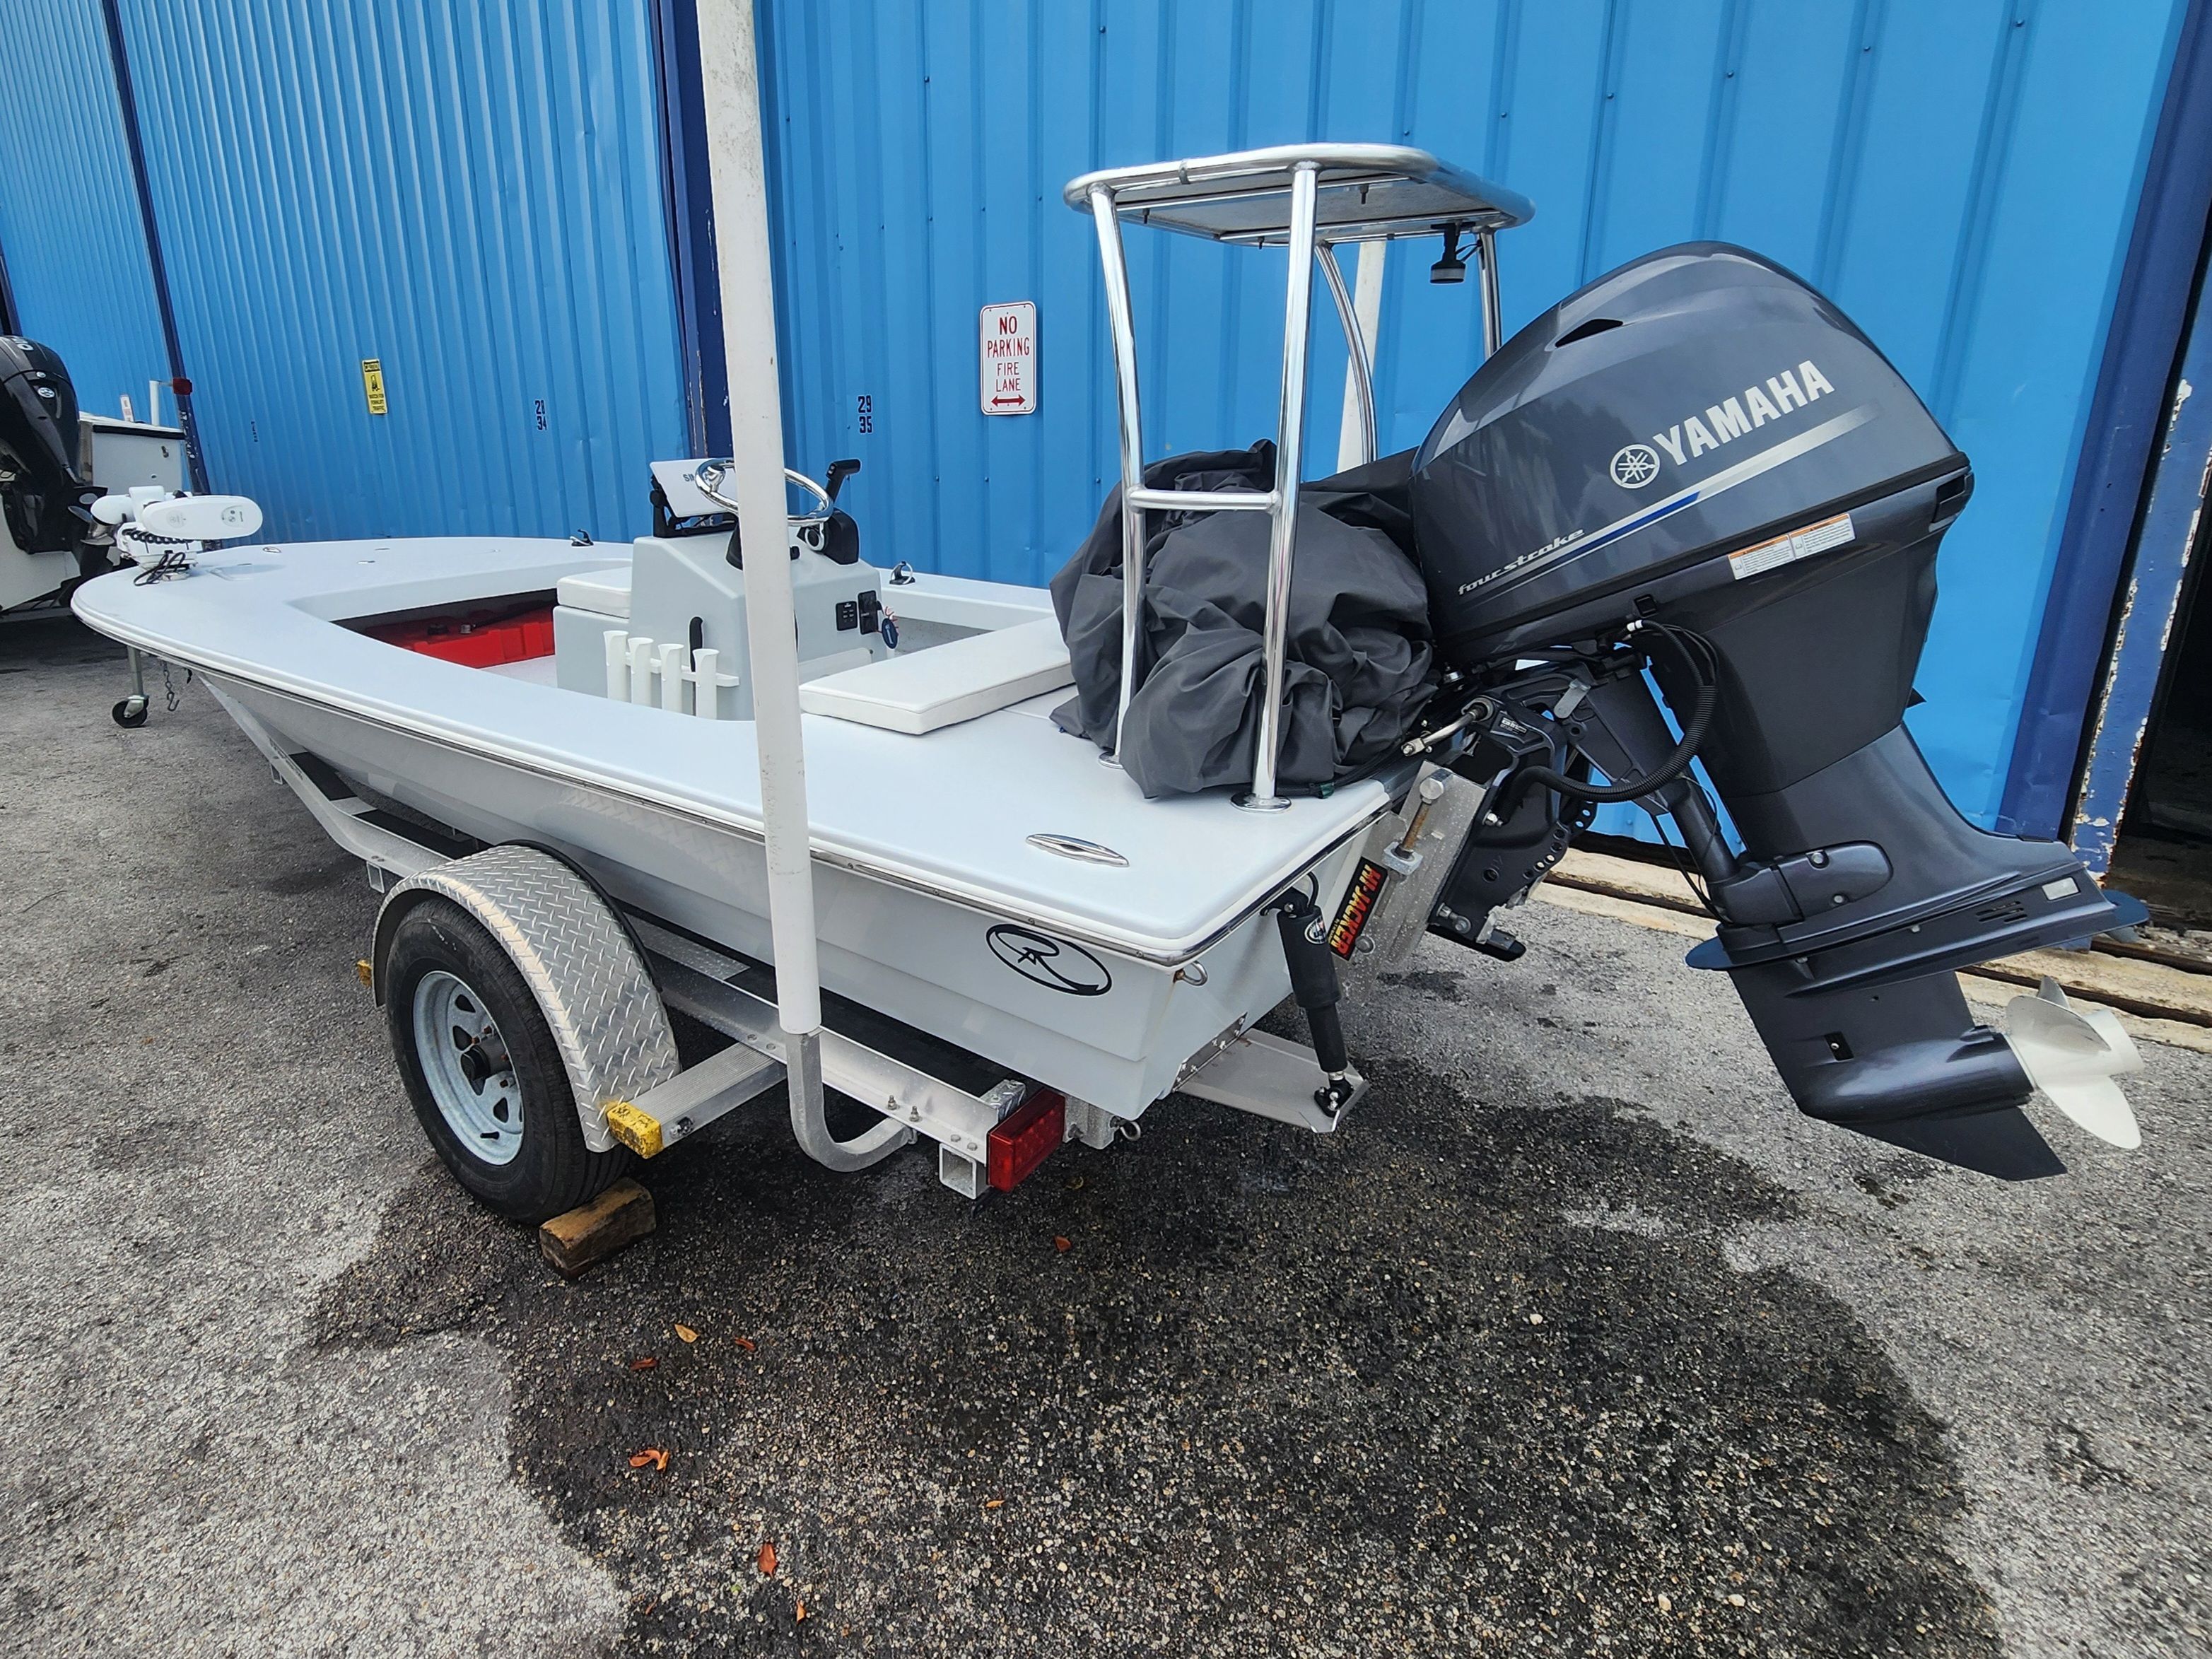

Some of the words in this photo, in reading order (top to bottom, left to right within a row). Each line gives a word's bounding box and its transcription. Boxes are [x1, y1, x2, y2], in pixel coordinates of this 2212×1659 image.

[999, 316, 1018, 335] NO
[987, 337, 1030, 358] PARKING
[997, 362, 1019, 376] FIRE
[995, 378, 1021, 392] LANE
[858, 394, 872, 413] 29
[1652, 360, 1835, 466] YAMAHA
[859, 416, 873, 433] 35
